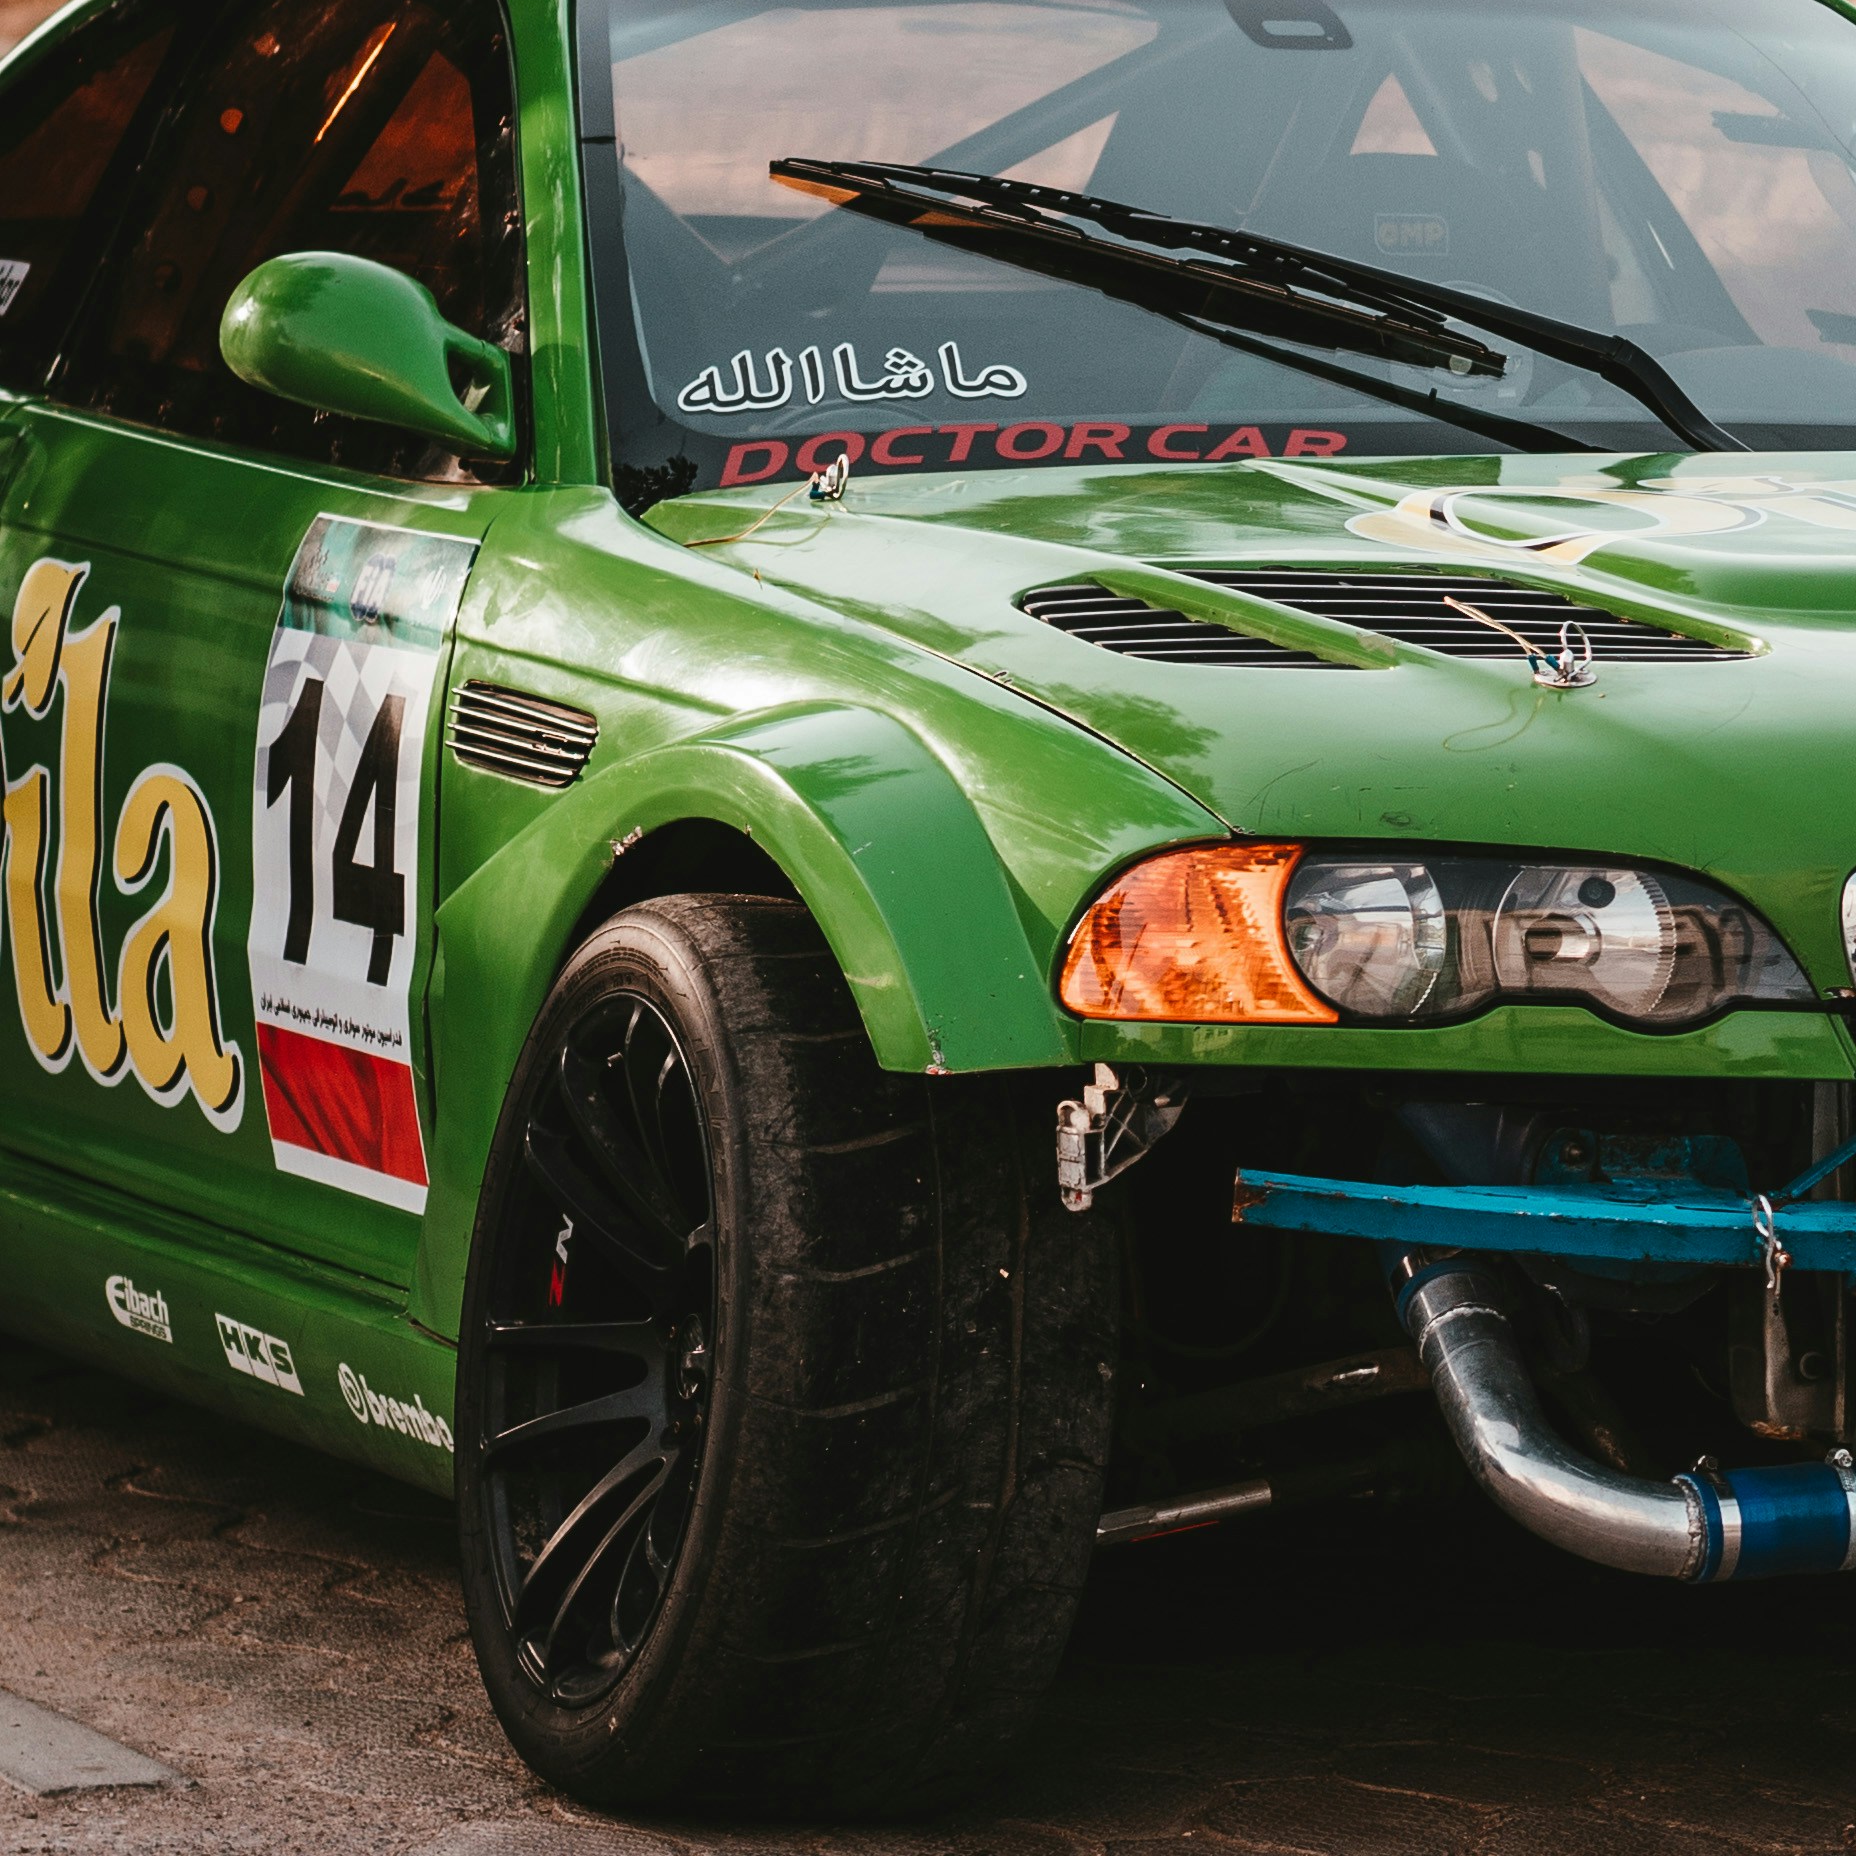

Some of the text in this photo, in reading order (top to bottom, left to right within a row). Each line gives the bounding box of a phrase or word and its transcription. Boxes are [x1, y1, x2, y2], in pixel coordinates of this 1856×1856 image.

[719, 421, 1348, 487] DOCTOR CAR
[350, 560, 396, 612] FIA
[0, 557, 244, 1134] ila
[267, 677, 405, 986] 14
[105, 1275, 170, 1328] Eibach
[219, 1320, 294, 1375] HKS
[357, 1373, 455, 1453] brembo
